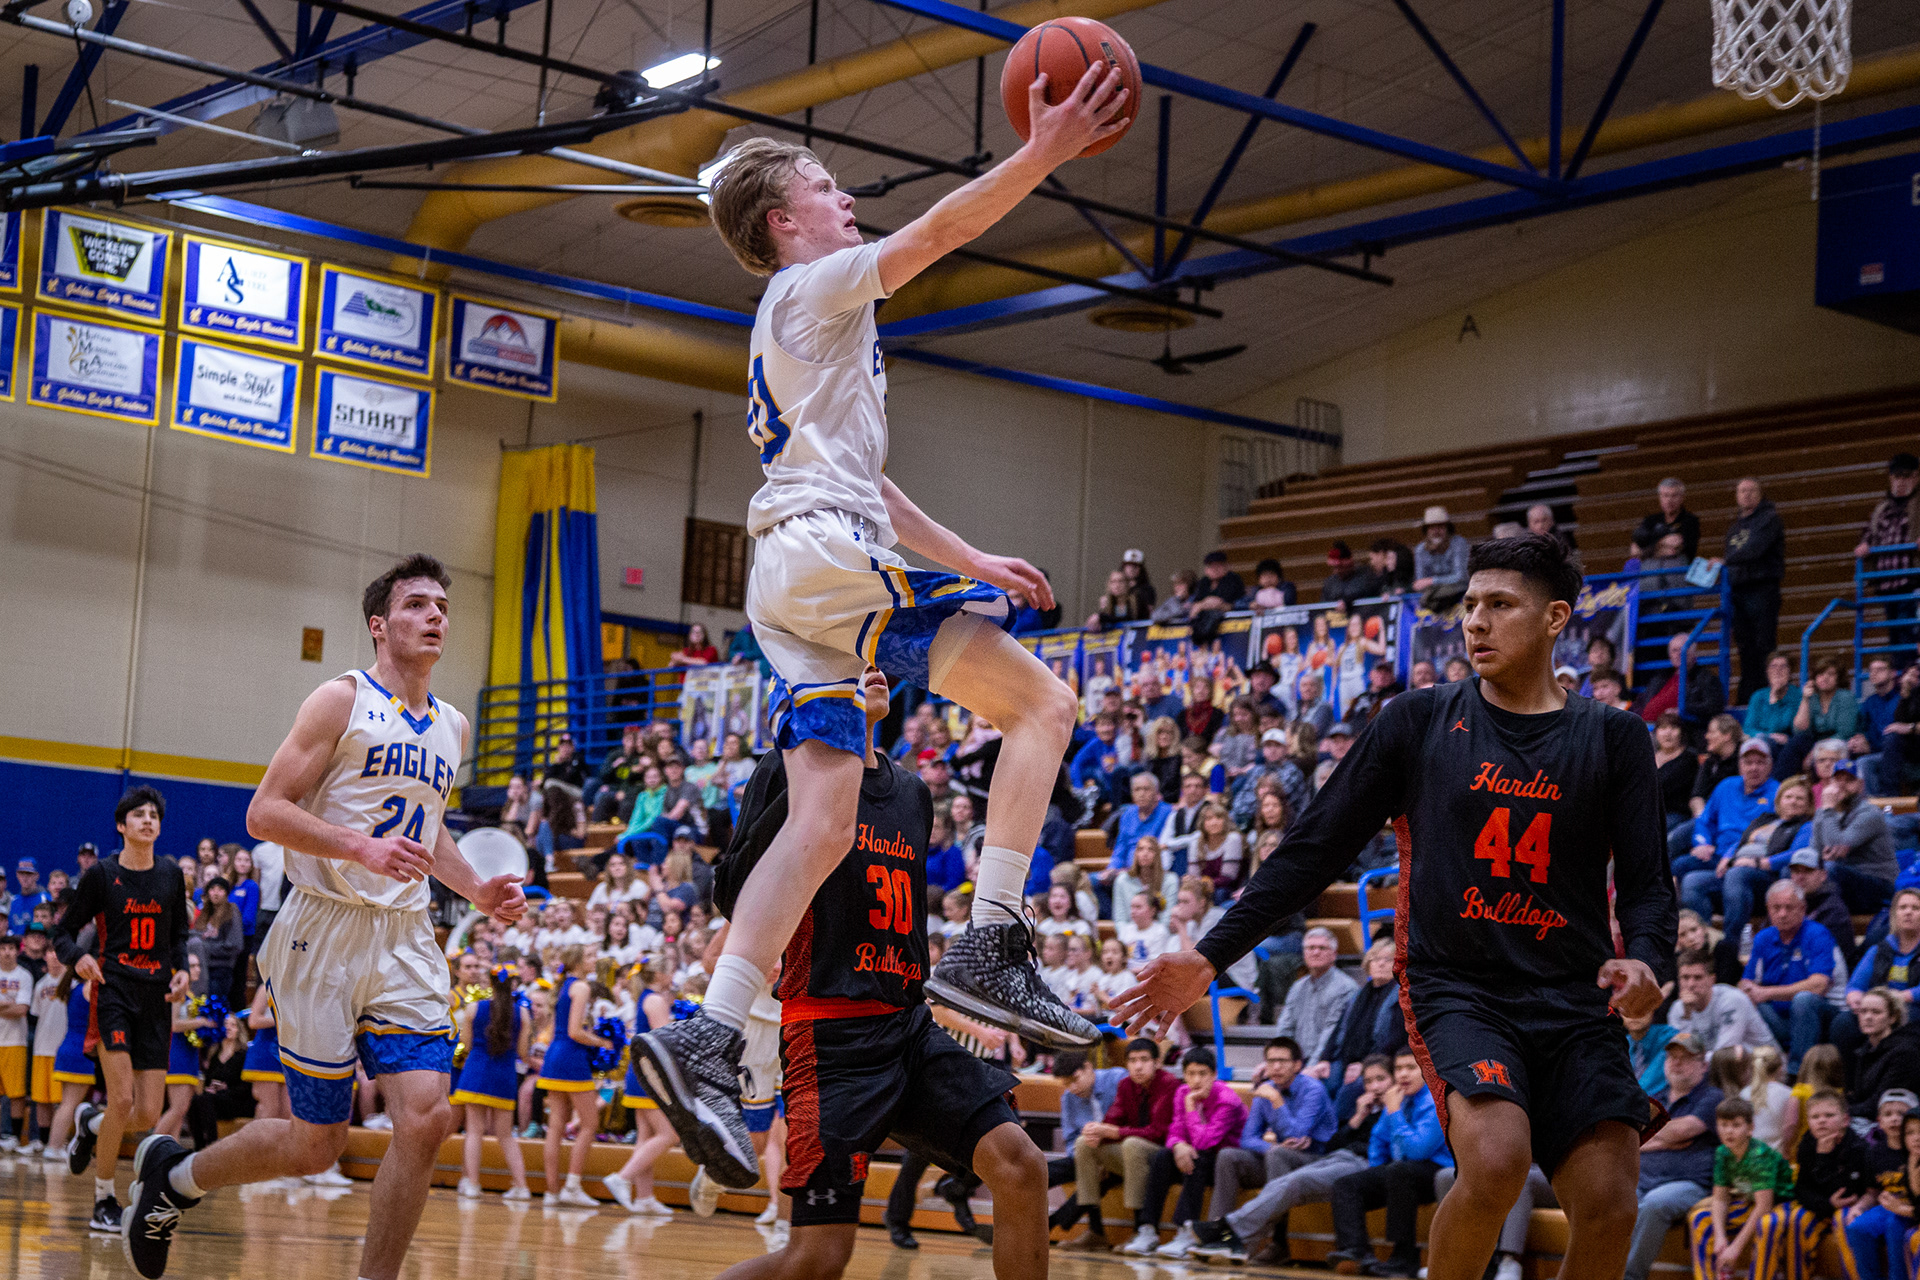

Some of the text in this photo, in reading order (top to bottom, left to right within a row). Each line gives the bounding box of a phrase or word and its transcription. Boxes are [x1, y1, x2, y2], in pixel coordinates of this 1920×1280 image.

[197, 365, 275, 399] Simple Style
[335, 404, 414, 435] SMART
[360, 742, 454, 801] EAGLES
[1470, 761, 1562, 801] Hardin
[371, 793, 426, 845] 24
[857, 823, 915, 861] Hardin
[1474, 806, 1552, 884] 44
[123, 897, 162, 914] Hardin
[866, 864, 913, 936] 30
[1459, 886, 1568, 941] Bulldogs
[129, 916, 156, 950] 10
